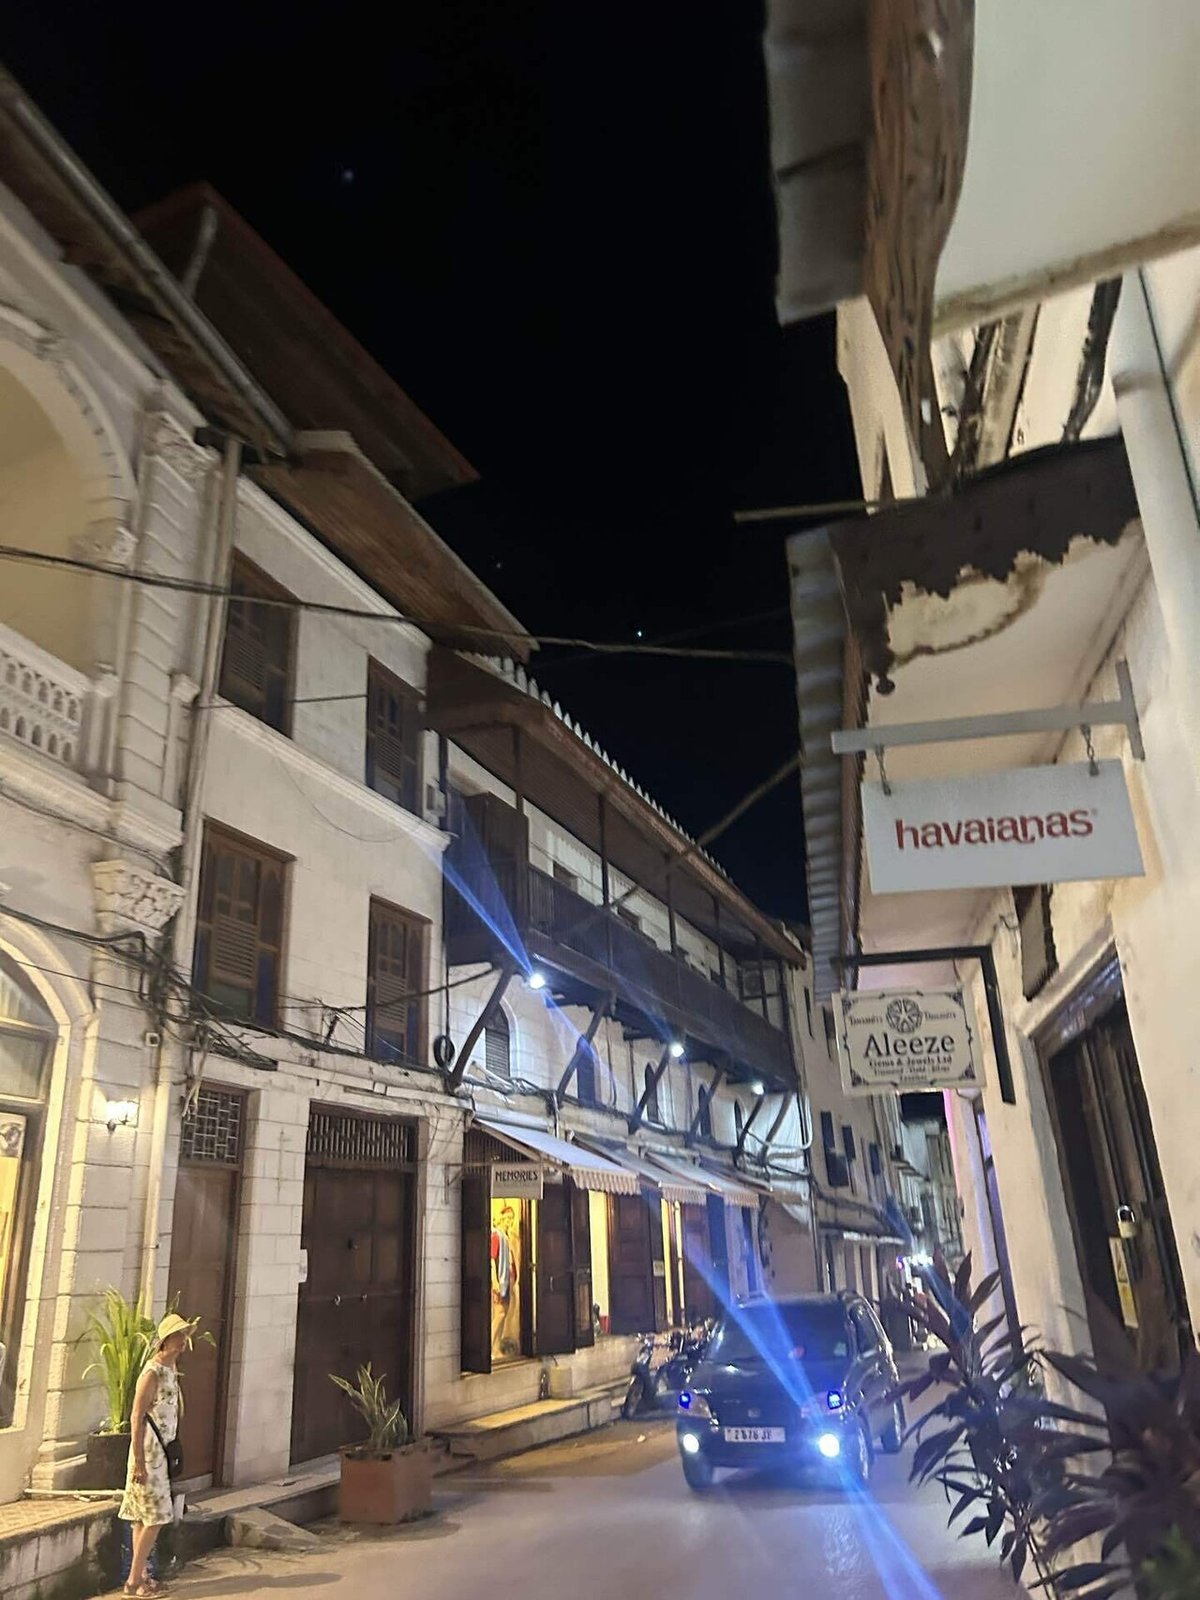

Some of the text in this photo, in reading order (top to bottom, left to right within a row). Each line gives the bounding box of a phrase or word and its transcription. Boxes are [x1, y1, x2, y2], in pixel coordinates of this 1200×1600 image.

[895, 808, 1094, 850] havaianas
[863, 1032, 955, 1058] Aleeze
[495, 1170, 538, 1182] MEMORIES
